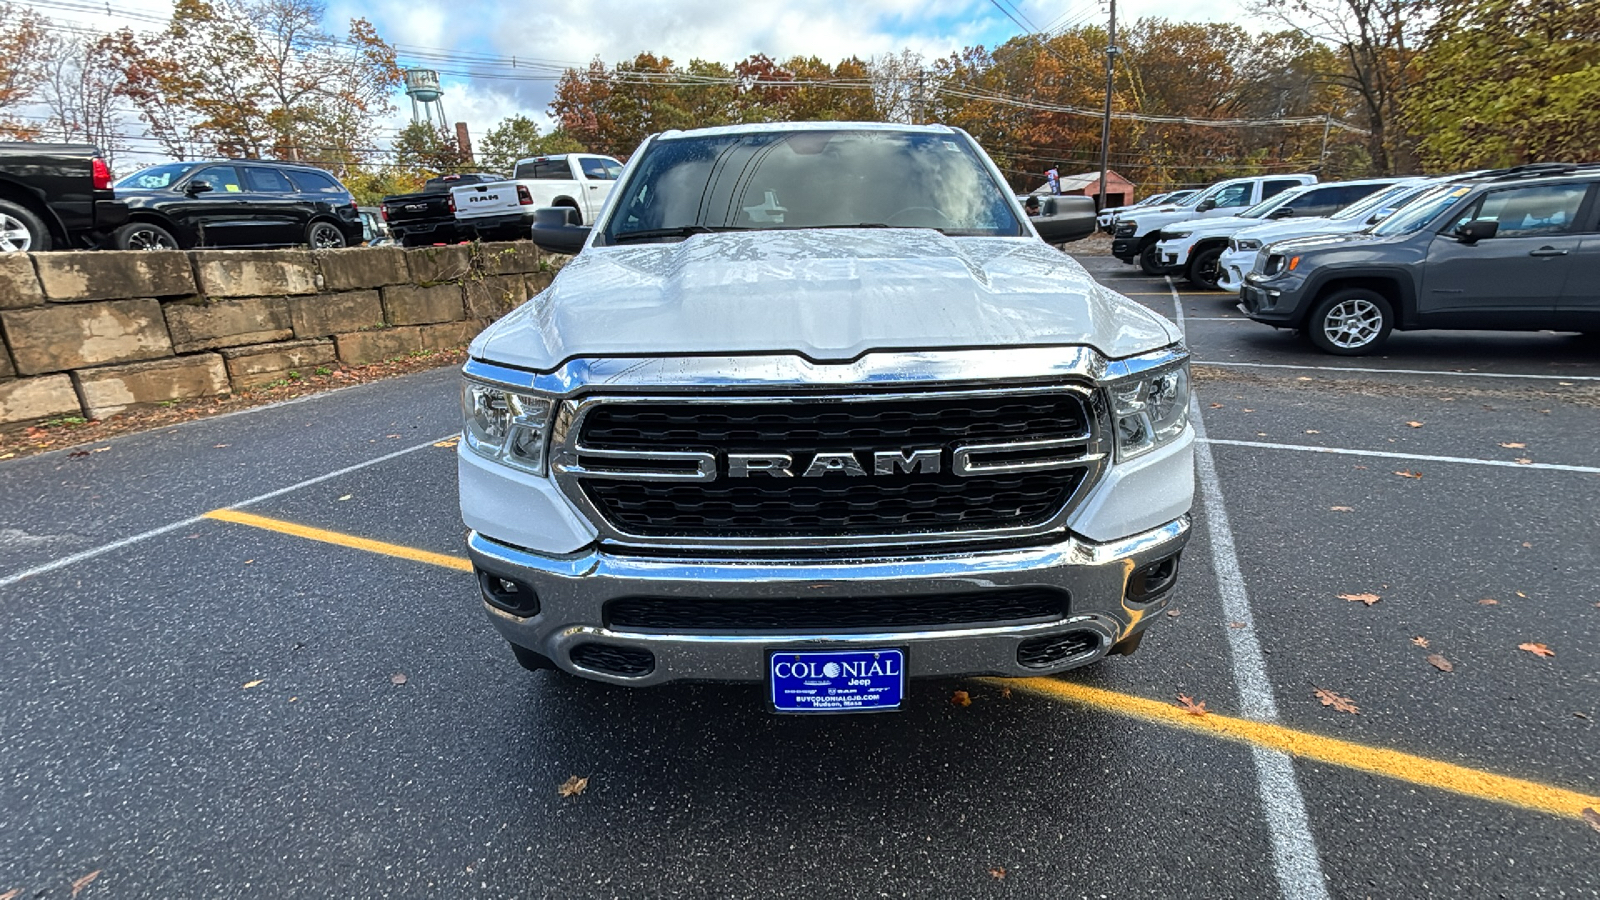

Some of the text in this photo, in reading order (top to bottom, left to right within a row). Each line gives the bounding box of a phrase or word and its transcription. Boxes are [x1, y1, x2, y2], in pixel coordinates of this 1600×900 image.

[469, 195, 499, 203] RAM
[728, 449, 942, 477] RAM
[775, 660, 899, 678] COLONIAL
[848, 678, 871, 687] Jeep
